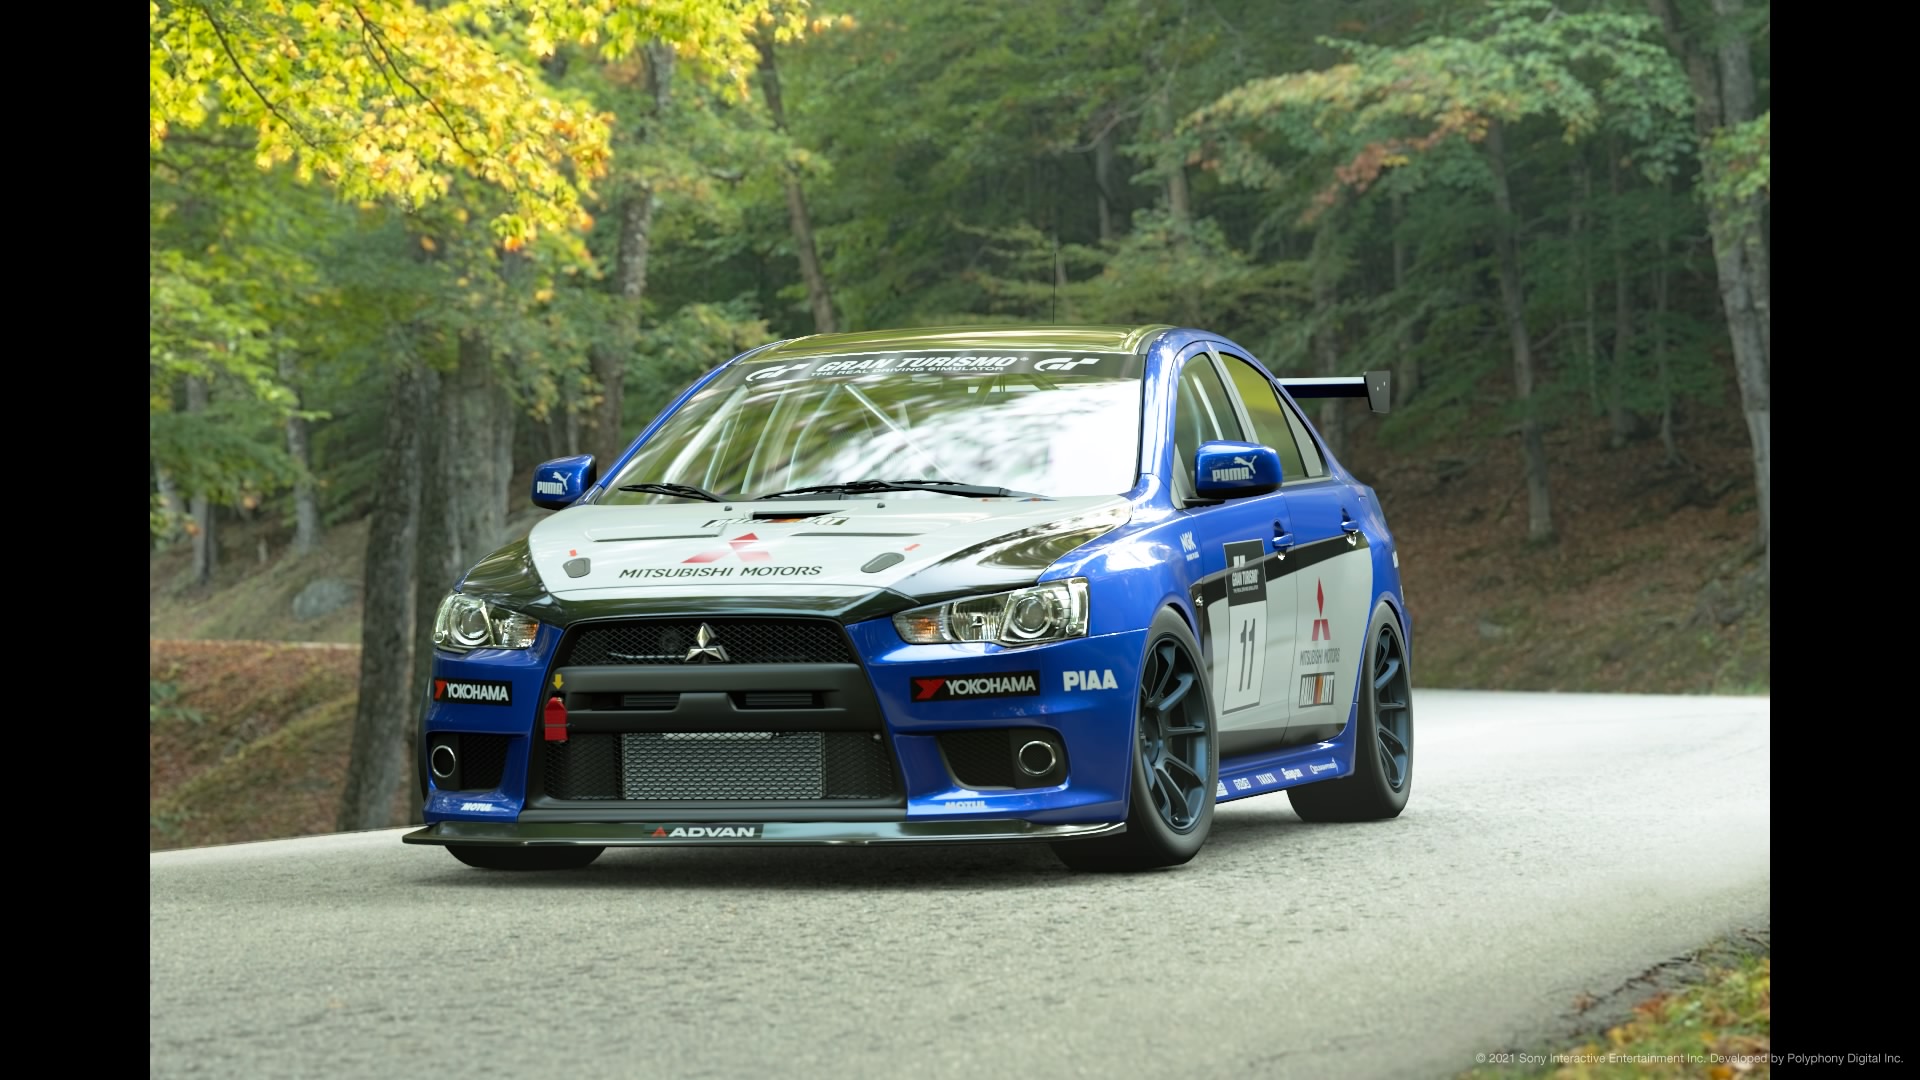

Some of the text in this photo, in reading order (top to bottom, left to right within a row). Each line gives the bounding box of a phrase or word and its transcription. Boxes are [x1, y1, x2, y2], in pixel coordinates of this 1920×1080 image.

[816, 356, 1018, 372] GRAN TURISMO
[618, 565, 823, 579] MITSUBISHI MOTORS
[1239, 618, 1256, 692] 11
[945, 675, 1036, 695] YOKOHAMA
[1062, 669, 1118, 691] PIAA
[446, 682, 509, 702] YOKOHAMA
[460, 802, 493, 812] MOTUL
[945, 801, 988, 809] MOTUL
[668, 826, 755, 838] ADVAN
